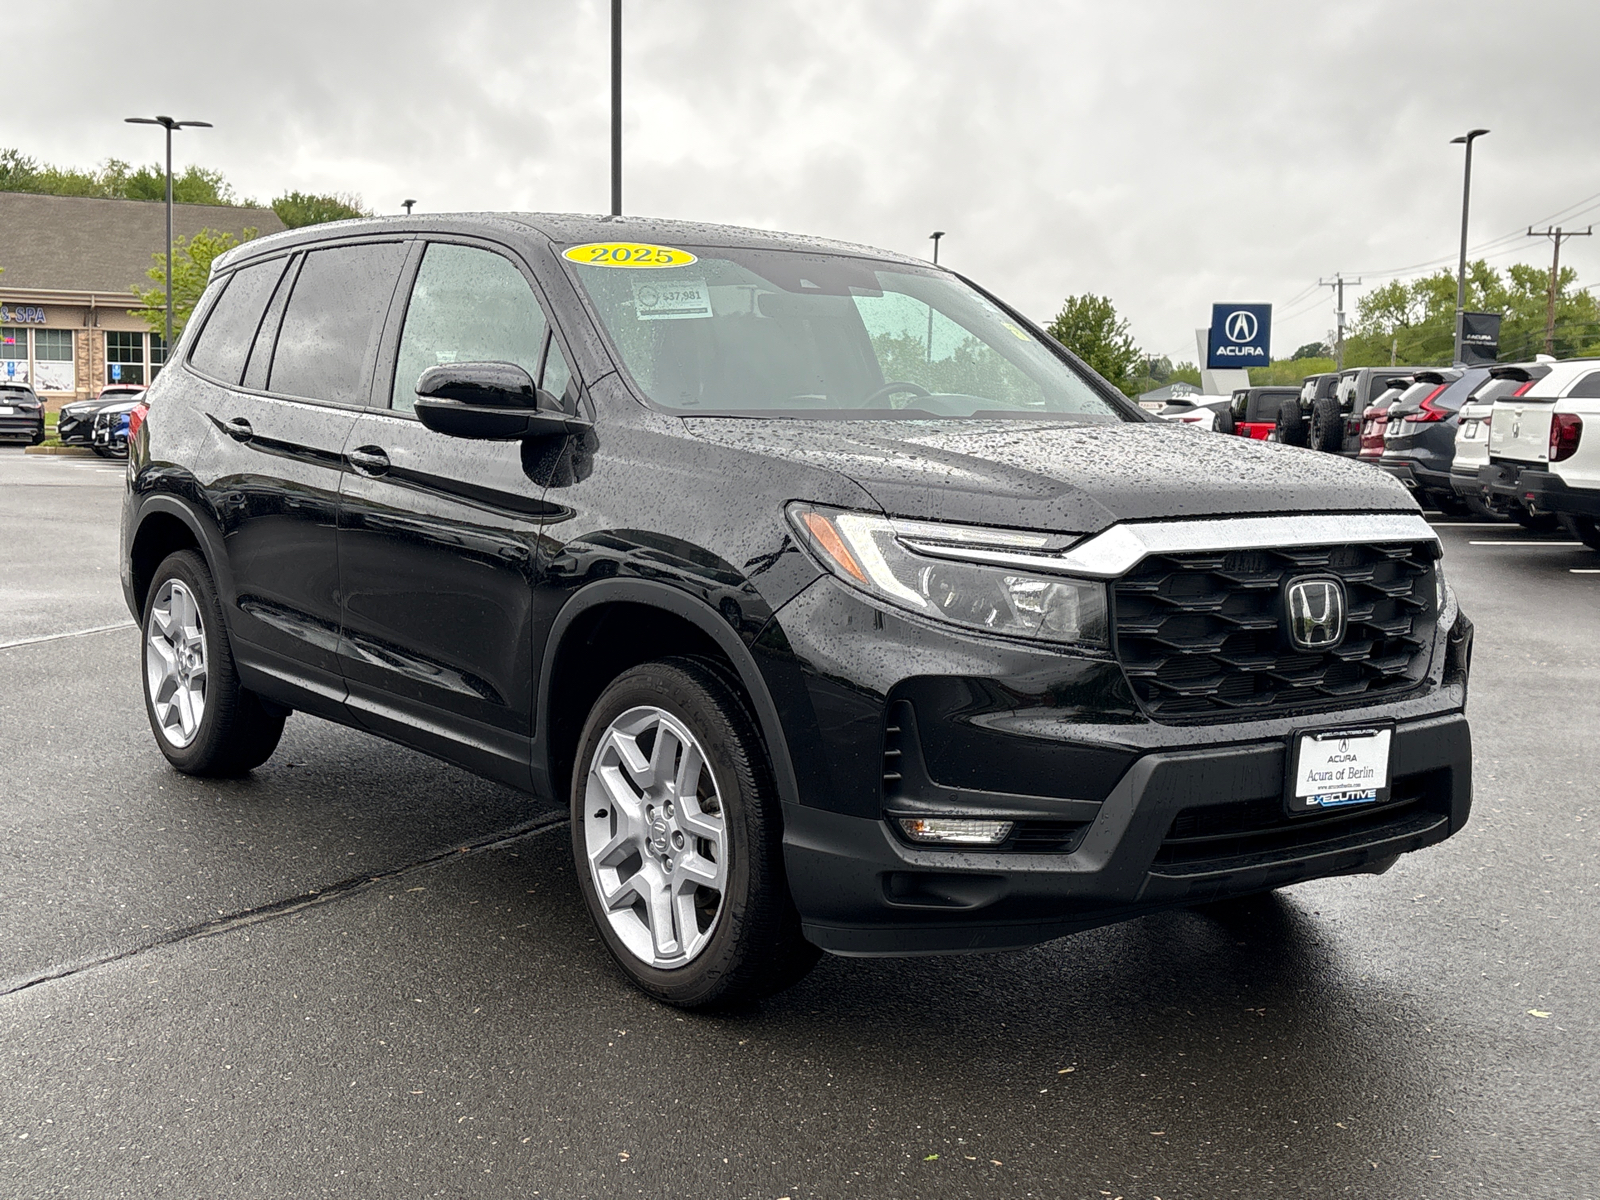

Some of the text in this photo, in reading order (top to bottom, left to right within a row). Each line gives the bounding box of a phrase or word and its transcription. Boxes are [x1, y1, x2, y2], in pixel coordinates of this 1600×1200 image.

[590, 247, 674, 264] 2025
[663, 290, 702, 303] $37,981
[15, 306, 47, 324] SPA
[1216, 345, 1265, 357] ACURA
[1327, 754, 1358, 764] ACURA
[1306, 766, 1374, 782] Acura of Berlin
[1306, 789, 1377, 806] EXECUTIVE
